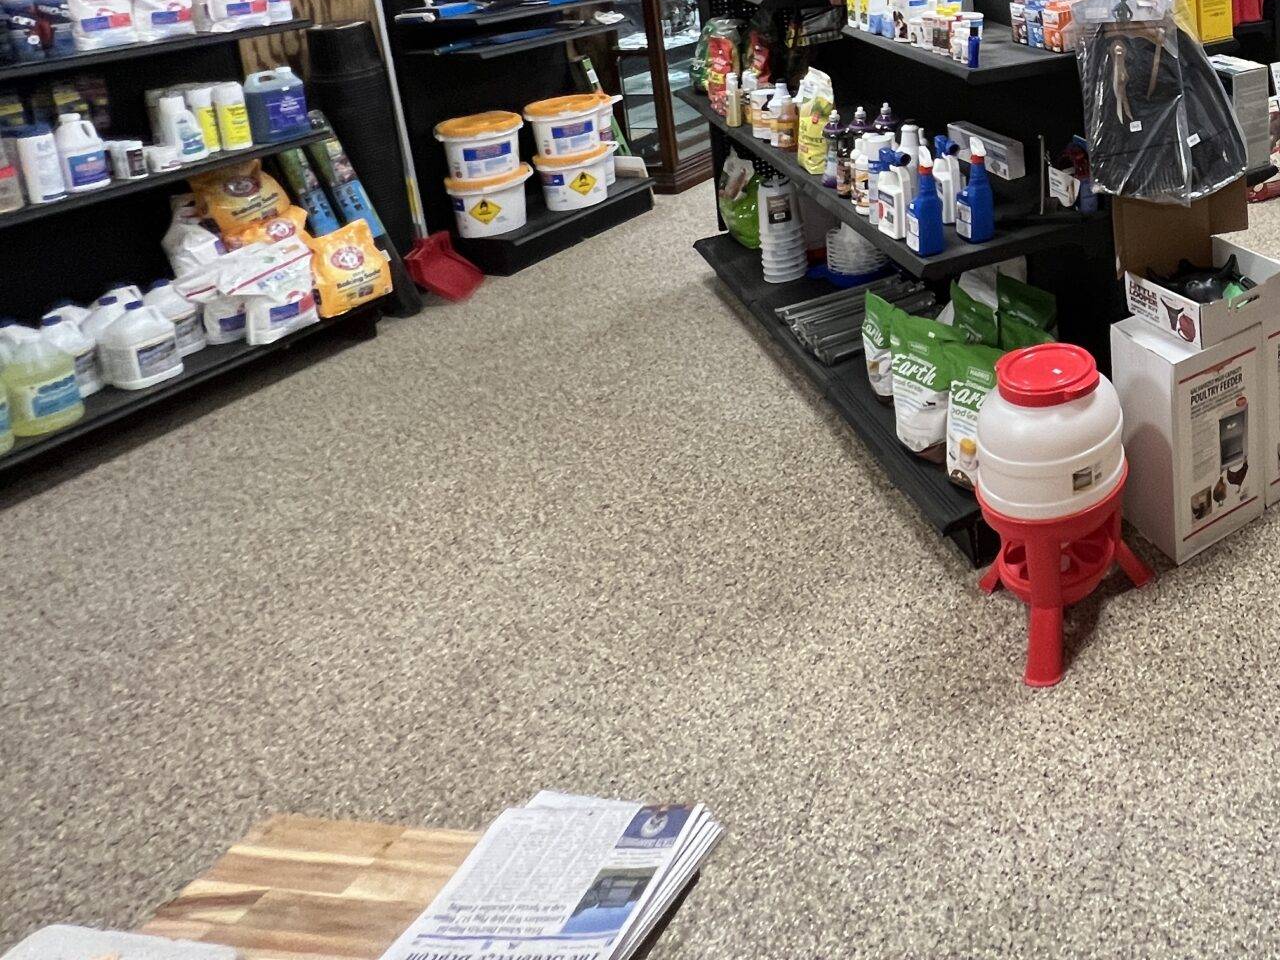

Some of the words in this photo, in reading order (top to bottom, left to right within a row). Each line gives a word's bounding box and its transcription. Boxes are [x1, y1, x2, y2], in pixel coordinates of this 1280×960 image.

[336, 277, 364, 290] Baking
[1129, 280, 1157, 300] LITTLE
[1129, 287, 1158, 308] LOOPER
[891, 353, 938, 386] Earth
[950, 380, 986, 410] Eart
[1190, 385, 1220, 406] POULTRY
[1219, 372, 1243, 392] FEEDER
